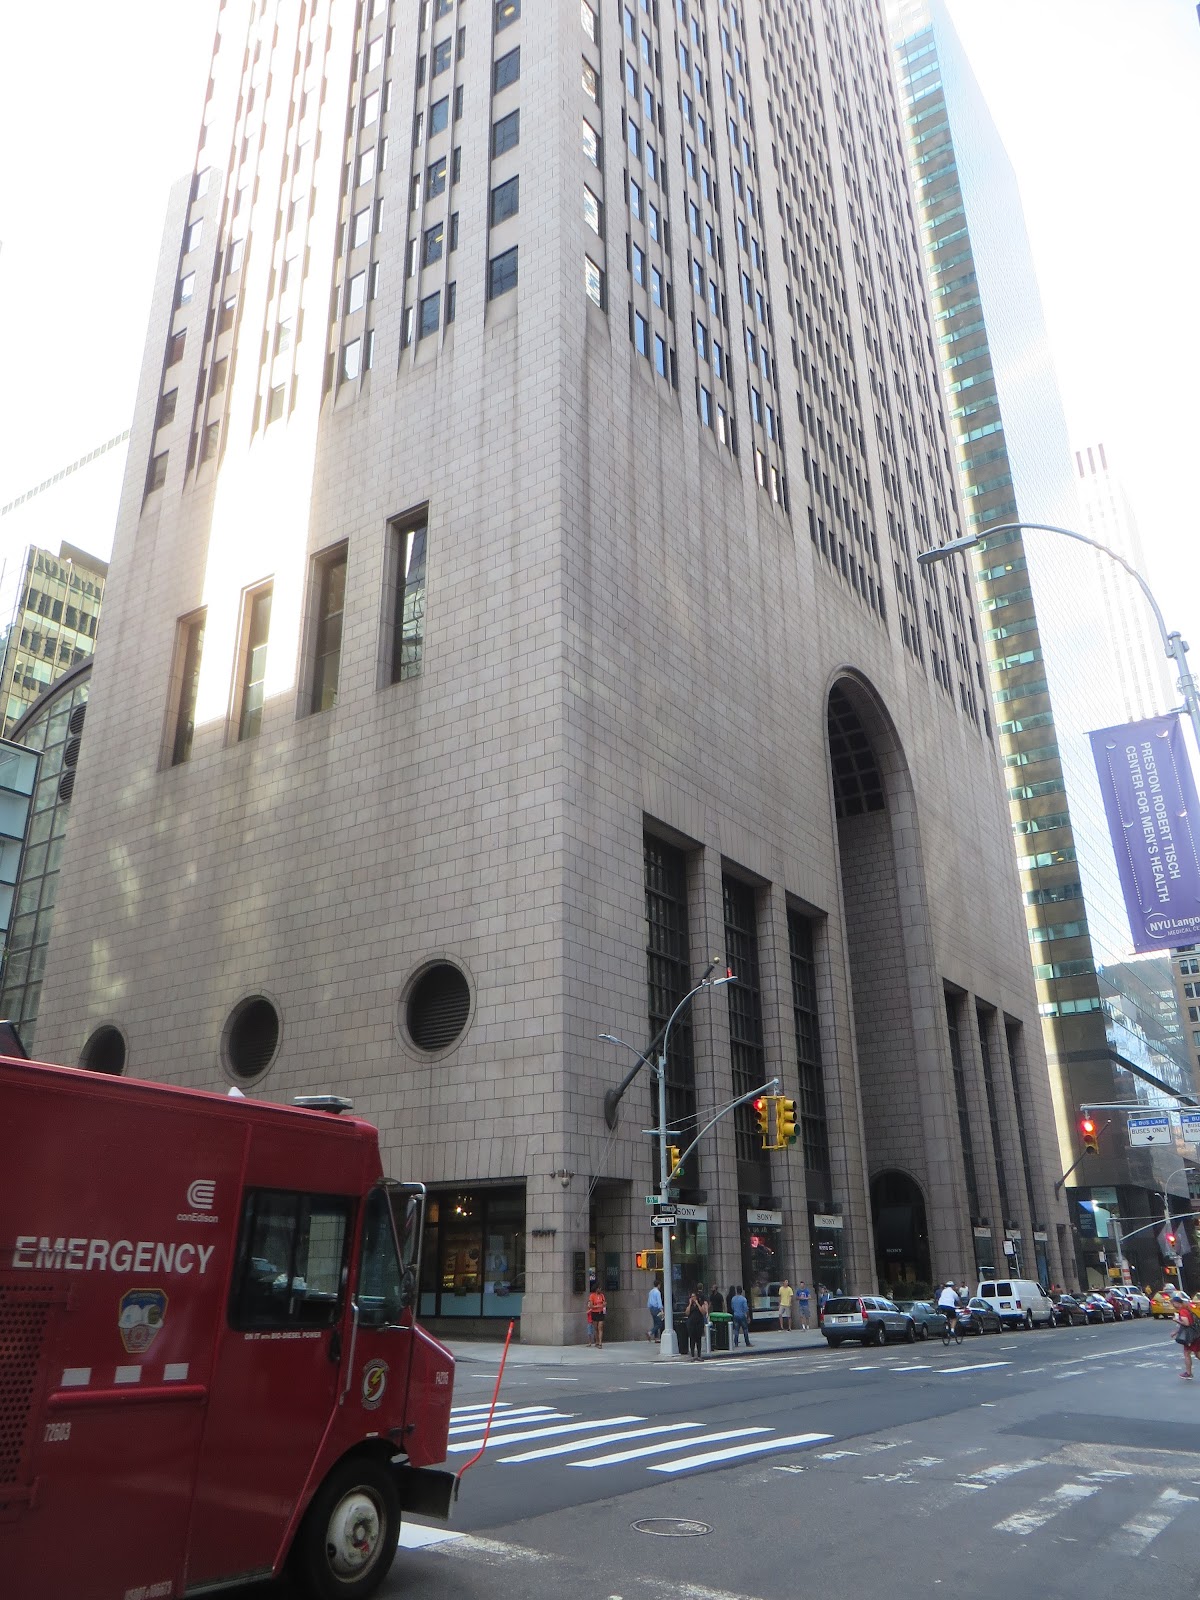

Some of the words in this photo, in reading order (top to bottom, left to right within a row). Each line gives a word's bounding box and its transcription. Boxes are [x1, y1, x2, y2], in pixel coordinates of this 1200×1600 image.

[1125, 745, 1144, 790] CENTER
[1135, 791, 1150, 815] FOR
[1140, 741, 1161, 794] PRESTON
[1152, 795, 1173, 841] ROBERT
[1163, 843, 1181, 879] TISCH
[1141, 815, 1159, 855] MEN'S
[1150, 856, 1170, 903] HEALTH
[1149, 919, 1171, 931] NYU
[1171, 916, 1200, 928] Lango
[1167, 927, 1192, 936] MEDICAL
[1131, 1127, 1151, 1135] BUSES
[177, 1212, 219, 1223] conEdison
[676, 1207, 696, 1216] SONY
[756, 1213, 773, 1221] SONY
[12, 1235, 215, 1274] EMERGENCY
